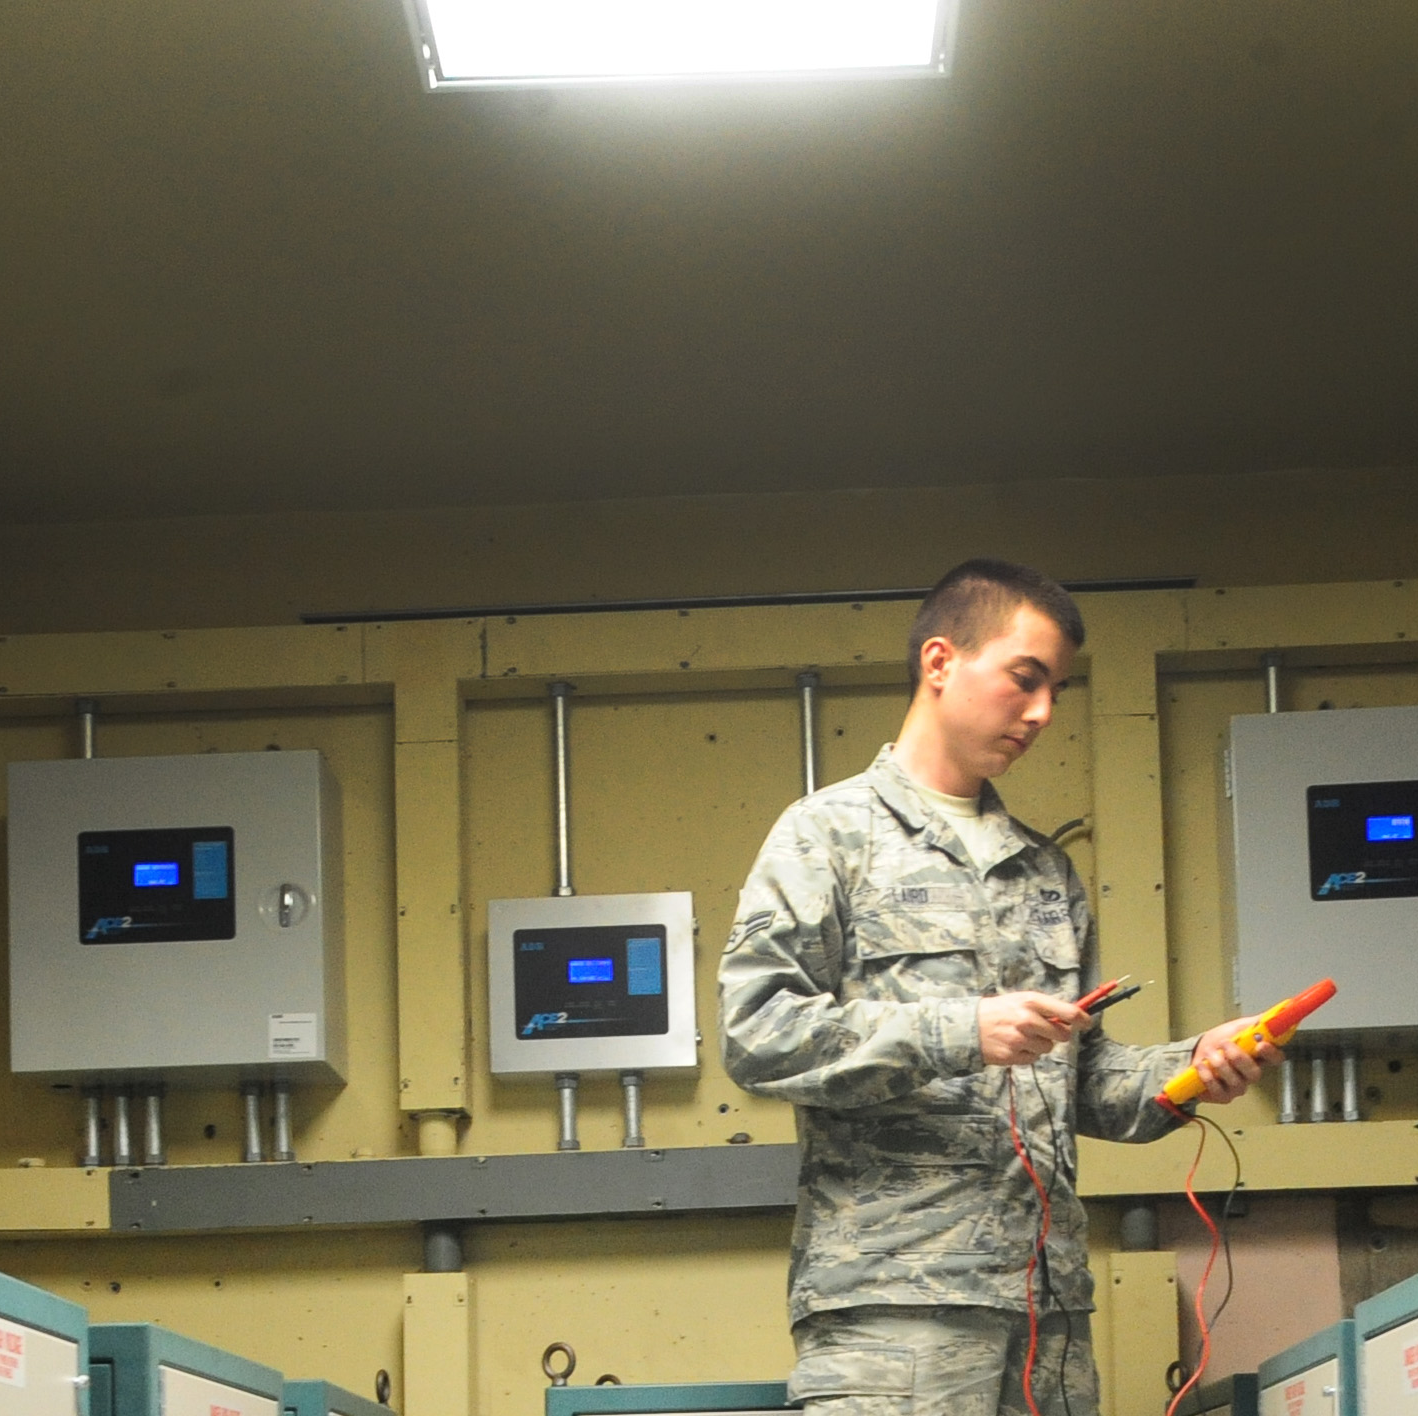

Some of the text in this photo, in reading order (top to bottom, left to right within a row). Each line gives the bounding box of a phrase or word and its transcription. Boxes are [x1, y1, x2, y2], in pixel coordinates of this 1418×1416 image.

[1317, 871, 1366, 895] ACE2
[86, 916, 132, 939] ACE2
[522, 1012, 568, 1035] ACE2
